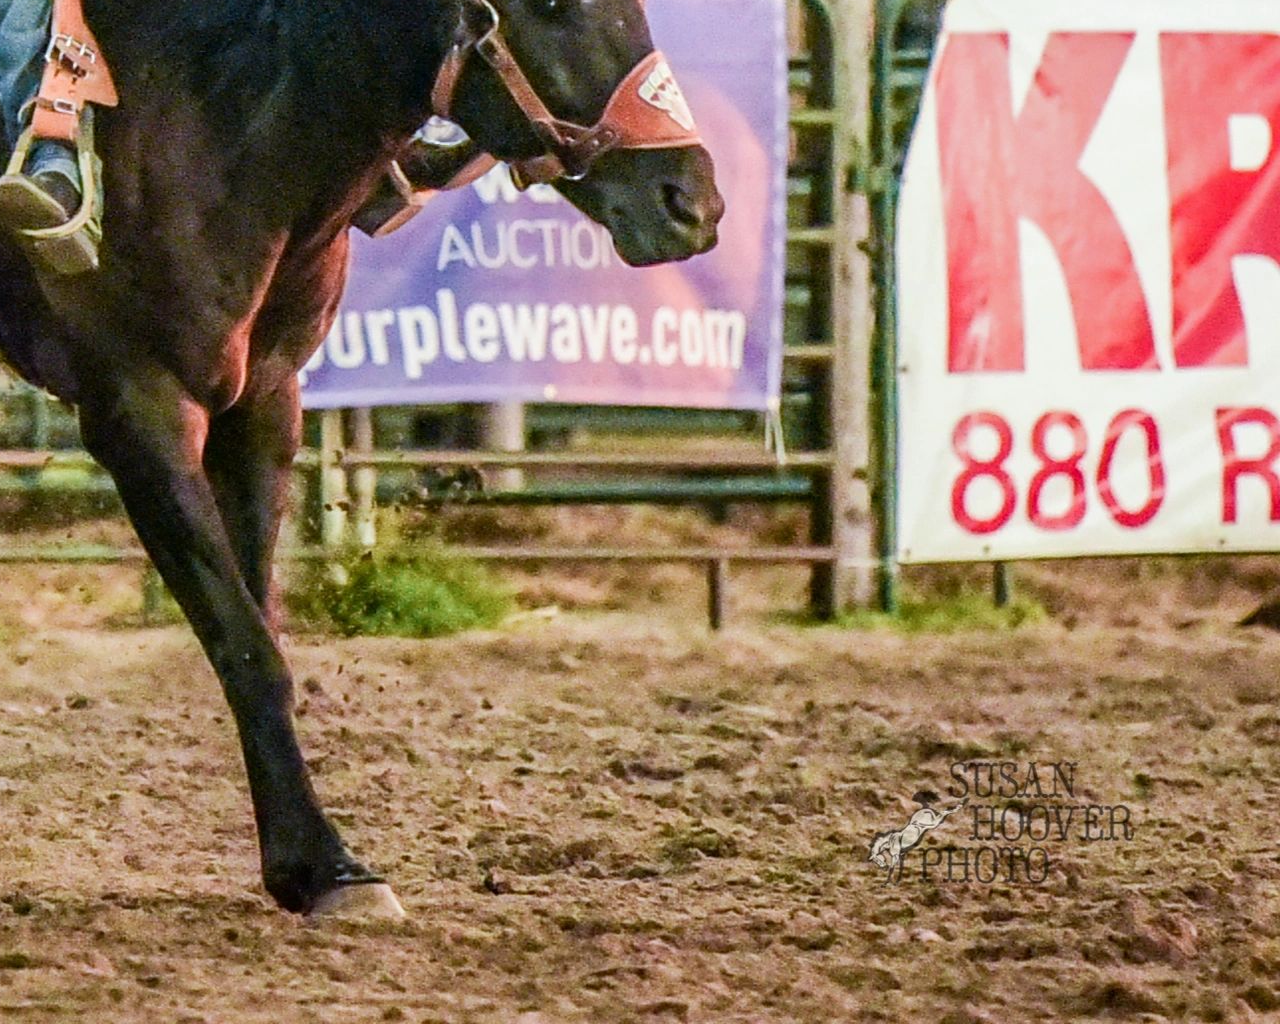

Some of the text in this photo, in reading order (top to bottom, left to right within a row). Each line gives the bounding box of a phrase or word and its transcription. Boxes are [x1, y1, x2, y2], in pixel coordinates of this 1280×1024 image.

[934, 30, 1280, 372] KR
[949, 406, 1280, 535] 880 R
